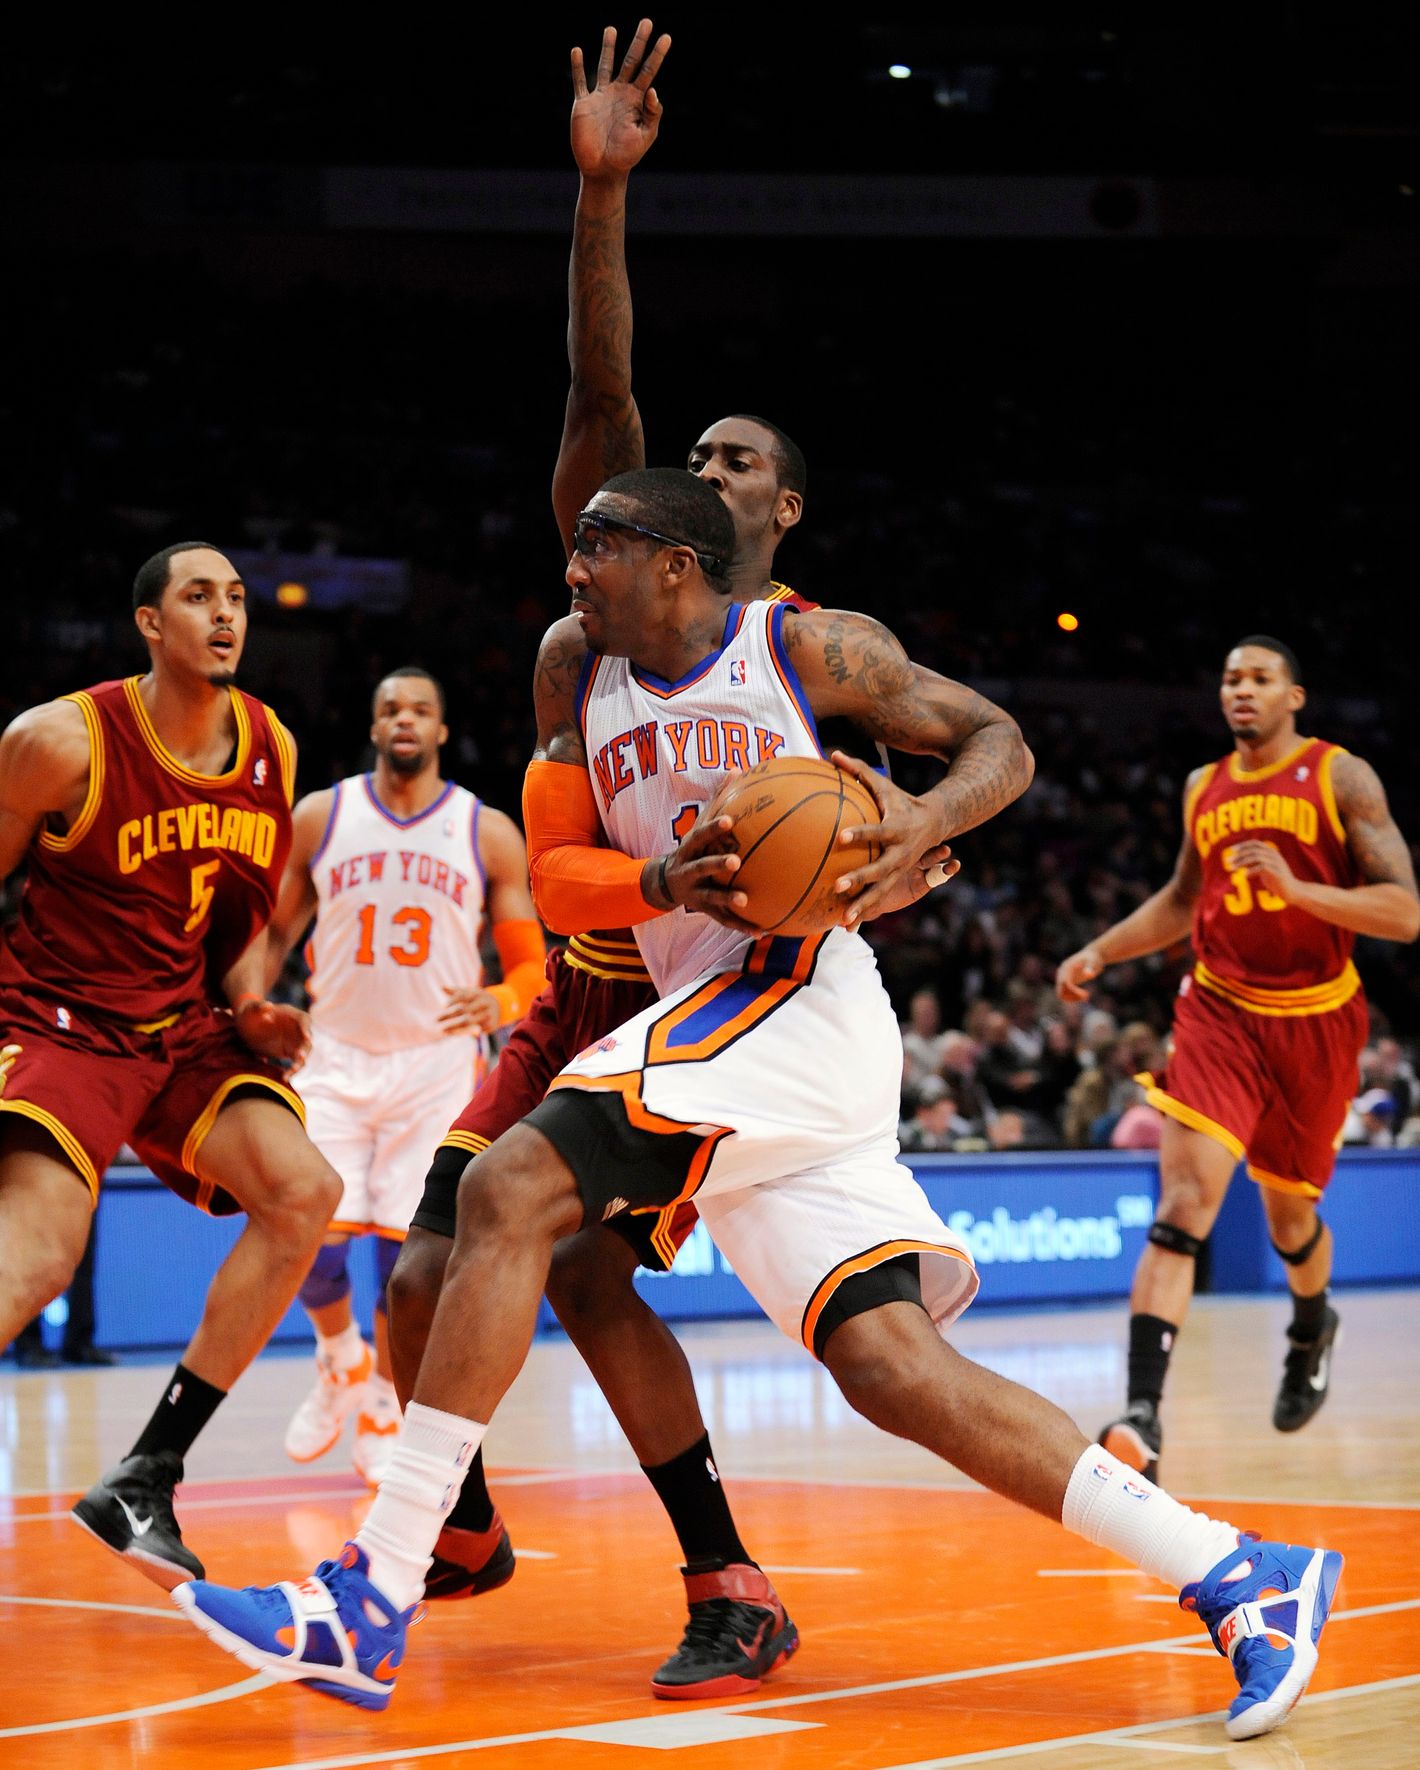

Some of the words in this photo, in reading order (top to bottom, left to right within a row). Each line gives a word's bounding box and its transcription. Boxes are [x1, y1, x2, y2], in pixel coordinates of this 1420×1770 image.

[593, 721, 657, 814] NEW
[664, 719, 785, 773] YORK
[118, 804, 277, 875] CLEVELAND
[1195, 794, 1318, 859] CLEVELAND
[184, 859, 220, 932] 5
[329, 852, 387, 899] NEW
[400, 851, 468, 909] YORK
[355, 905, 432, 967] 13
